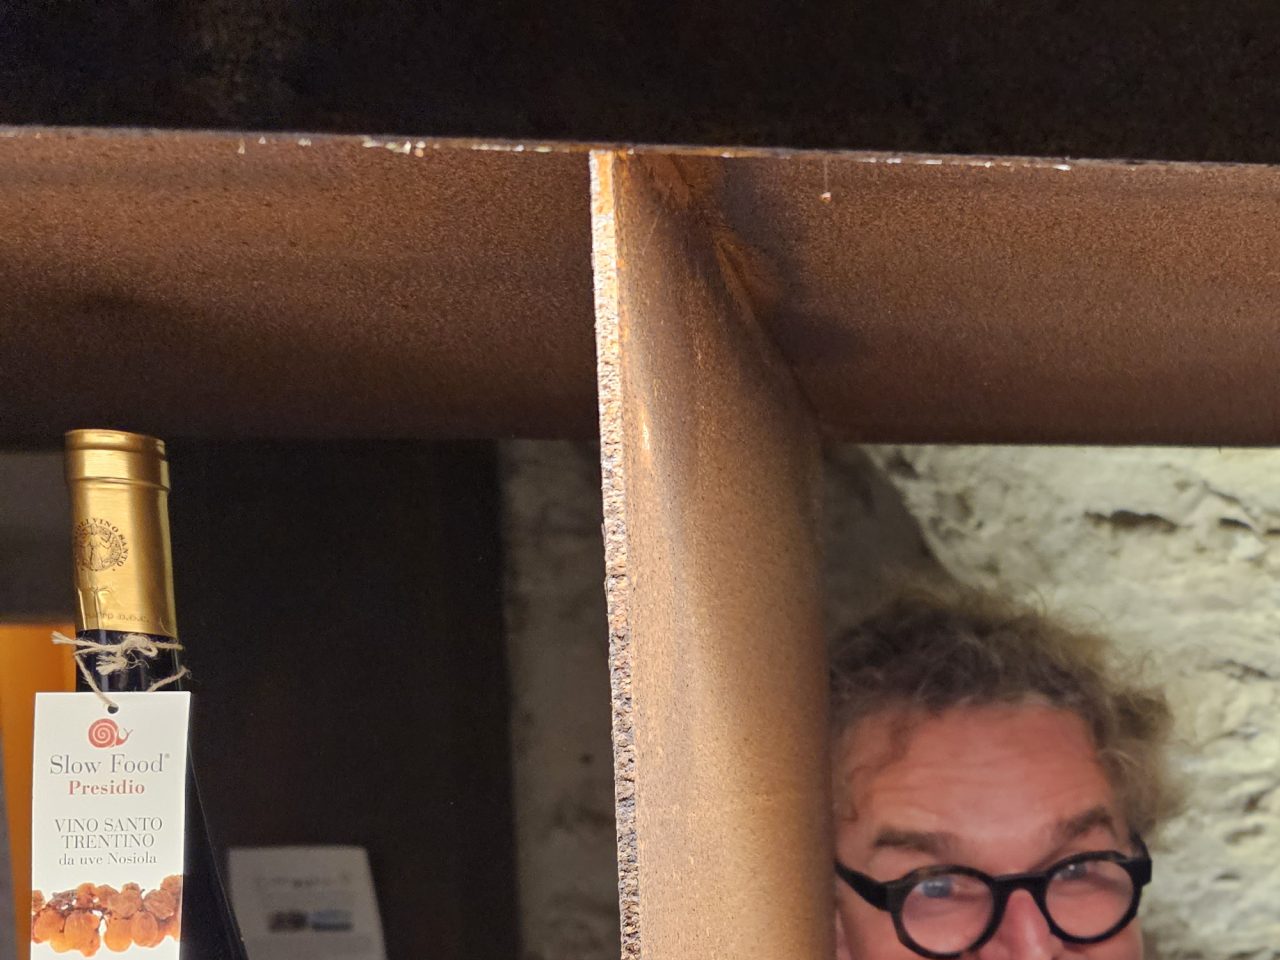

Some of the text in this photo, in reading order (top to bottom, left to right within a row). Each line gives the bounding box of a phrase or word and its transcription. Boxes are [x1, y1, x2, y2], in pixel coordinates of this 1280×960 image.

[50, 754, 101, 775] Slow
[69, 780, 145, 795] Presidio
[55, 817, 163, 832] VINO SANTO
[61, 833, 155, 849] TRENTINO
[59, 852, 157, 866] da uve Nosiola
